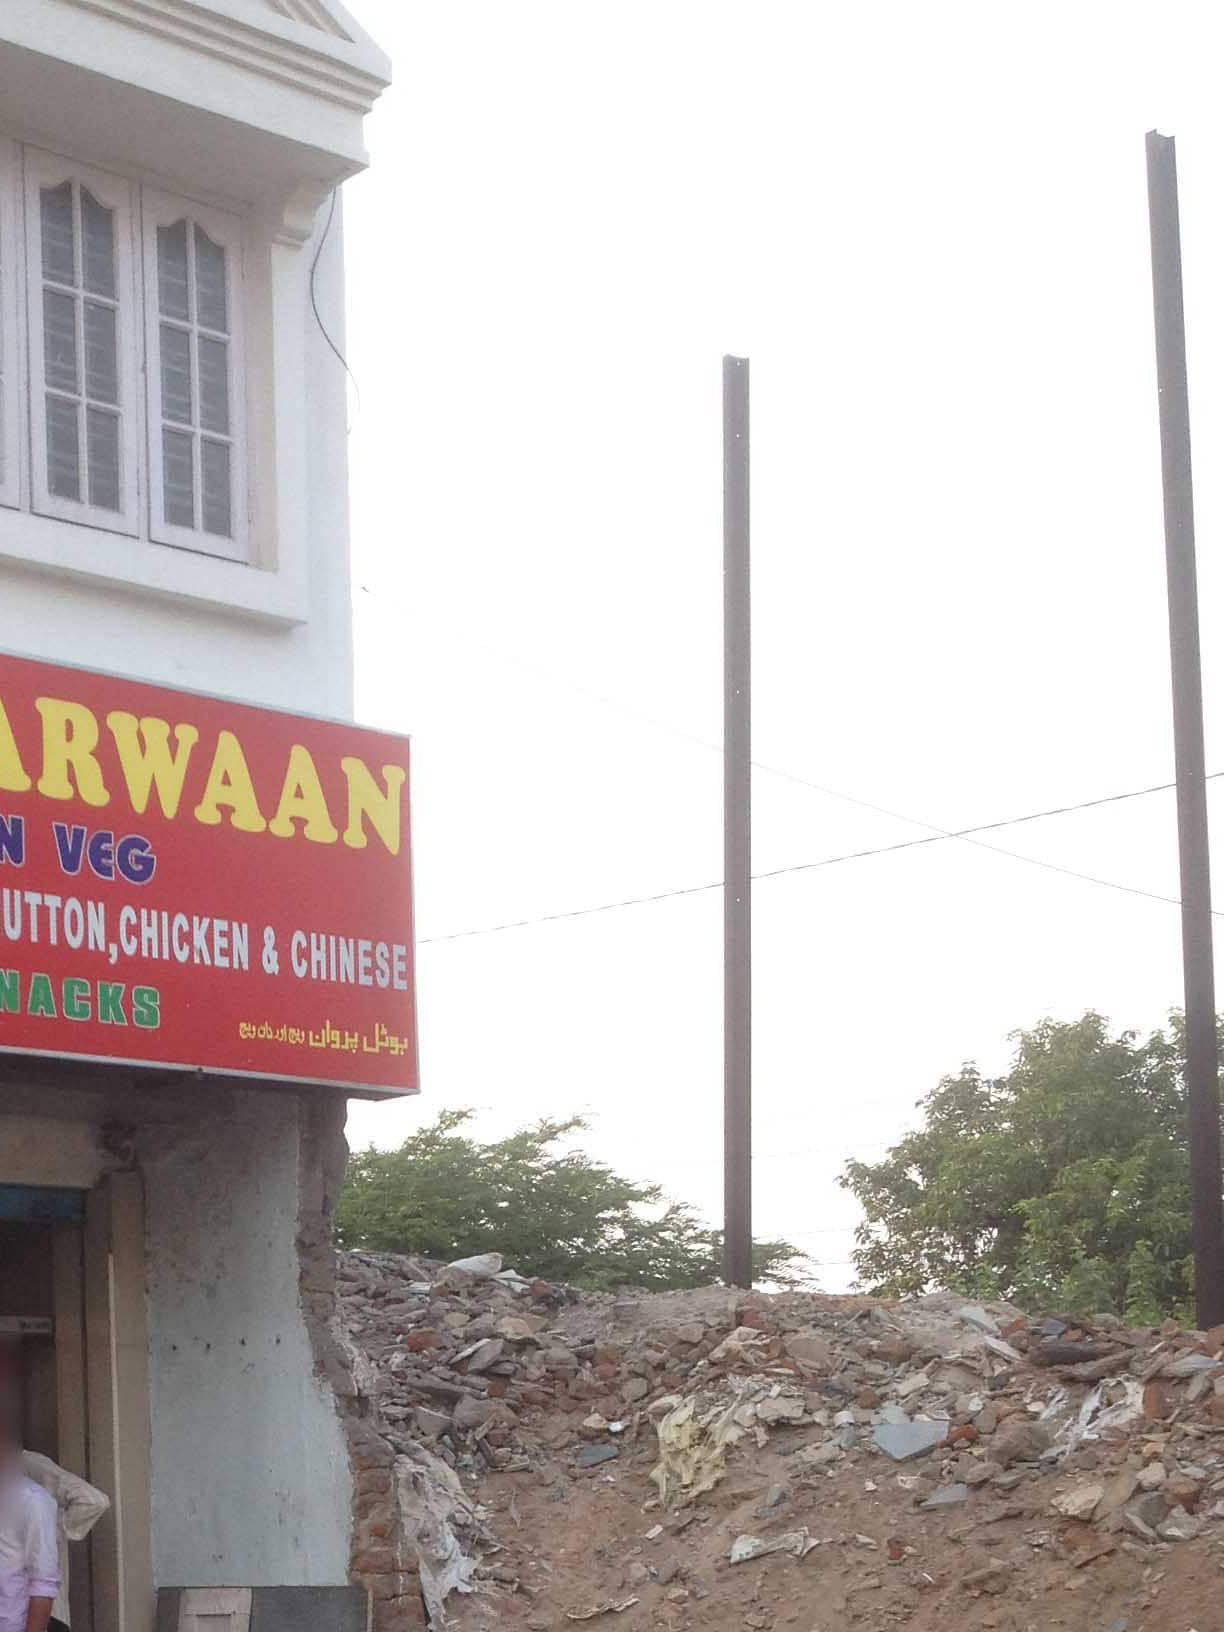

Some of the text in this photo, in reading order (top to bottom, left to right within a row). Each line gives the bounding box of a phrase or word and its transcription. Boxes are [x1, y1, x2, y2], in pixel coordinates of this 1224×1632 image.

[54, 821, 157, 885] VEG
[261, 926, 279, 975] &
[290, 930, 408, 991] CHINESE
